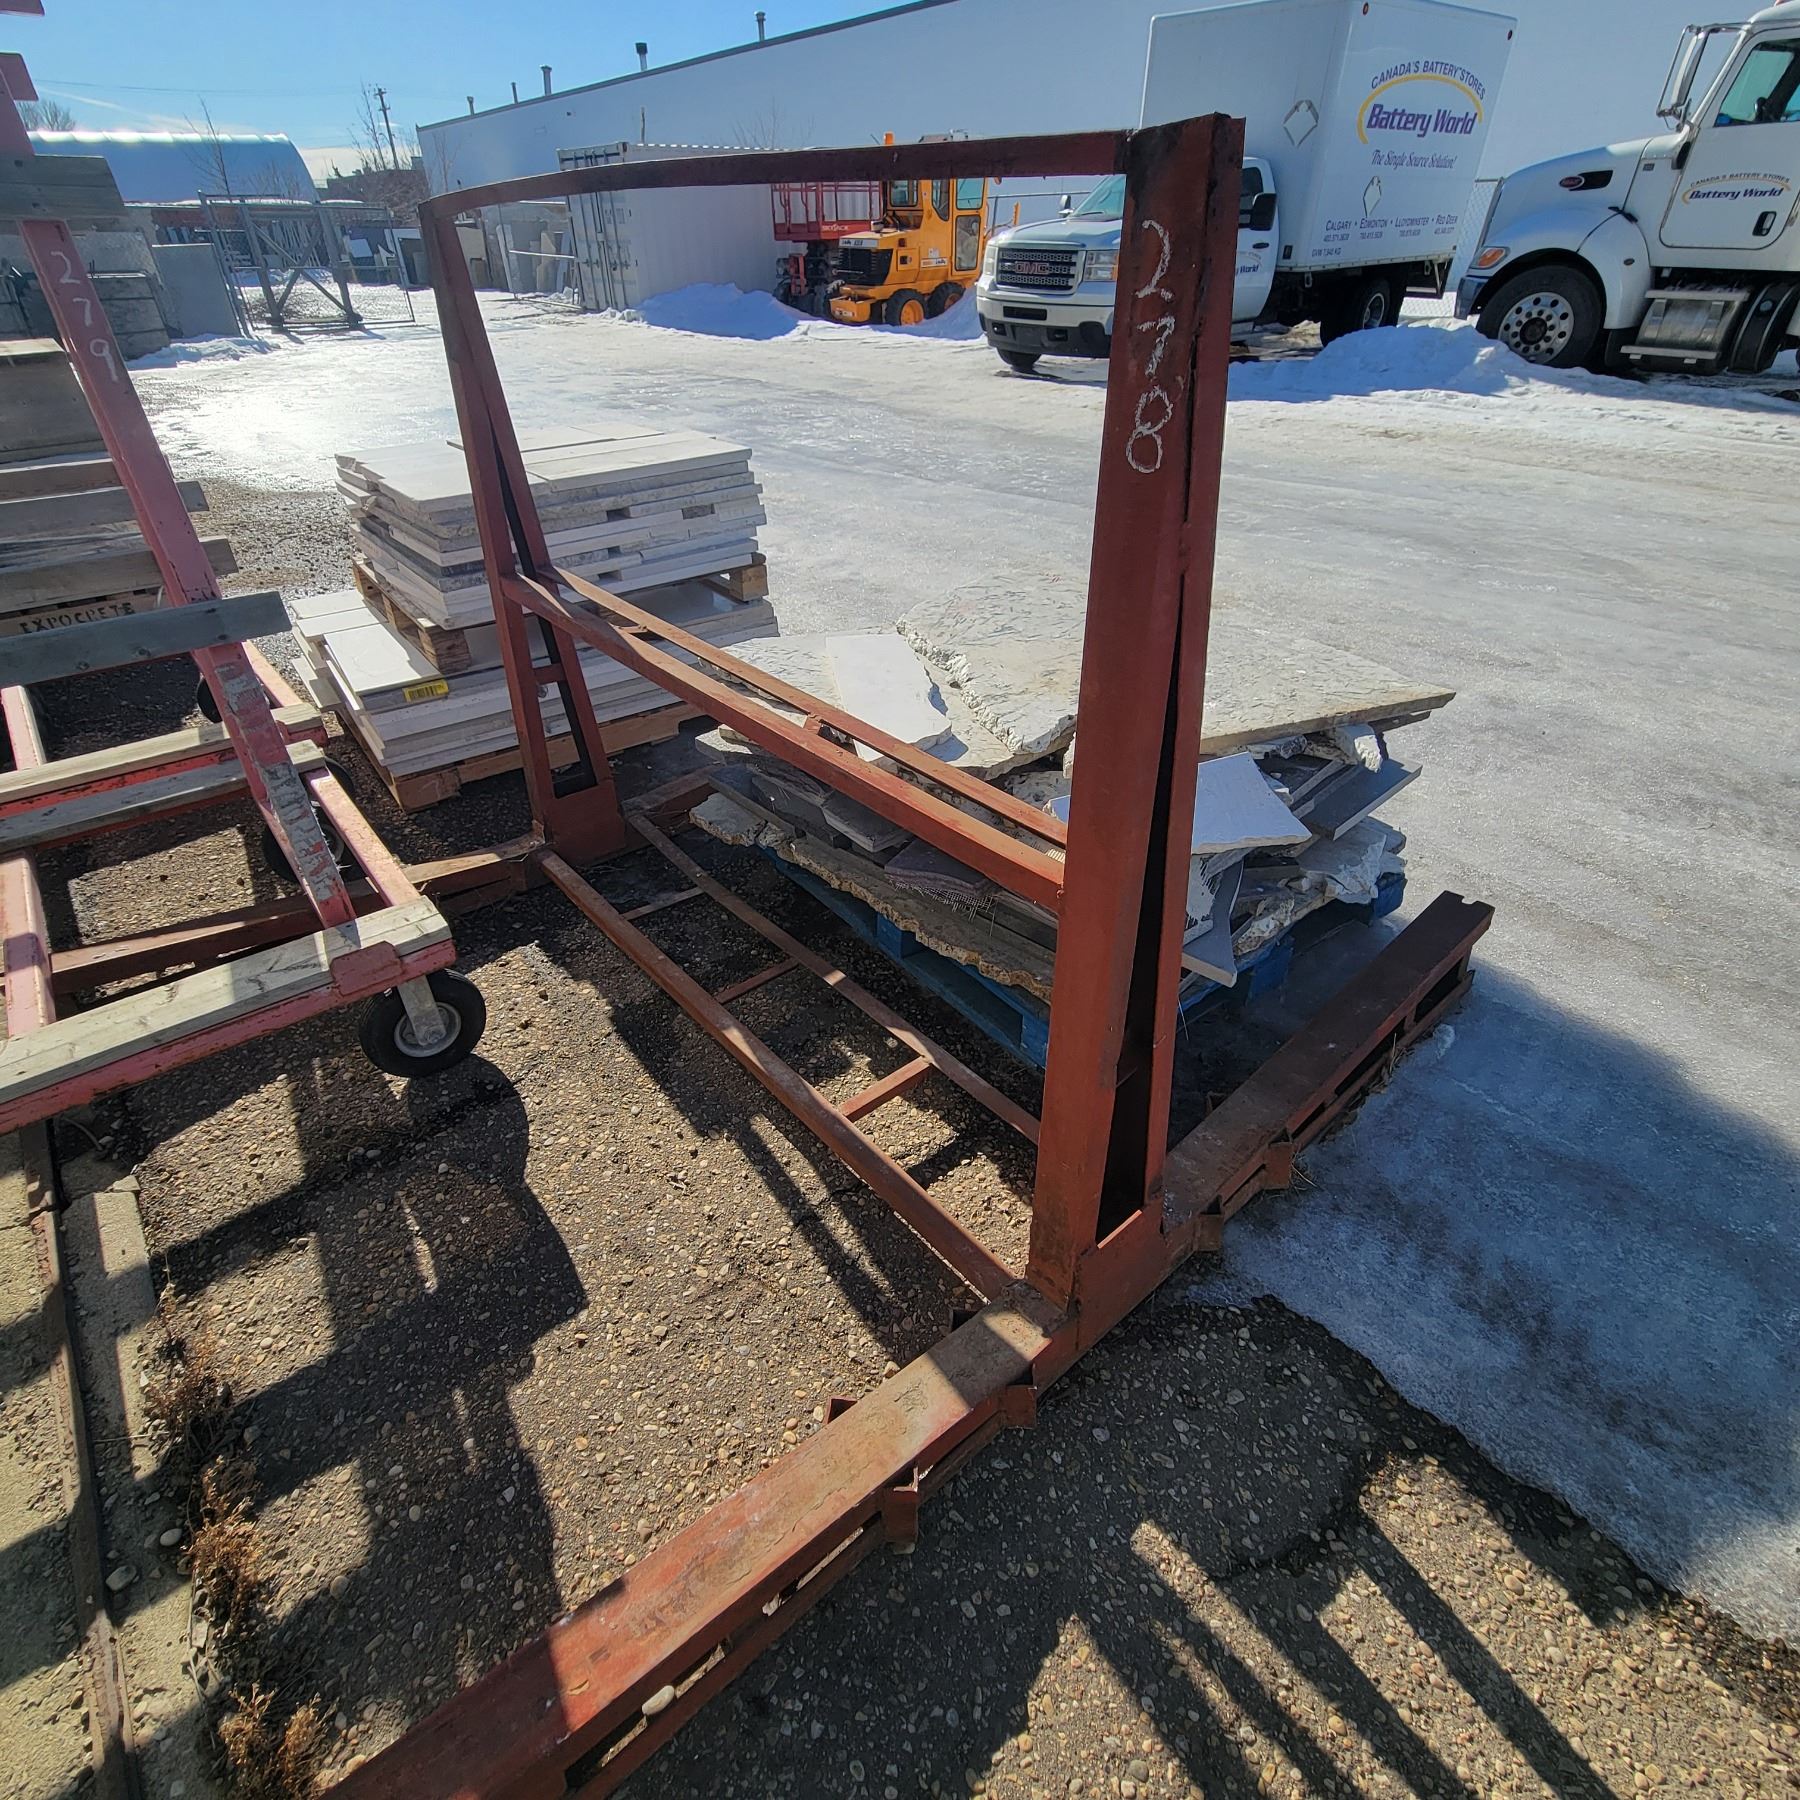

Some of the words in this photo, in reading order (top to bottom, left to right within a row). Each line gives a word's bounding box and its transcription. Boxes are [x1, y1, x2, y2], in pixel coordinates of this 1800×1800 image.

[1371, 60, 1420, 90] CANADA'S
[1422, 60, 1459, 78] BATTERY
[1459, 68, 1486, 101] STORES
[1366, 103, 1432, 138] Battery
[1433, 108, 1478, 134] World
[1371, 149, 1383, 166] The
[1405, 151, 1428, 168] Source
[1763, 172, 1790, 184] STORES
[1688, 190, 1741, 200] Battery
[1743, 187, 1784, 197] World
[1015, 261, 1049, 274] GMC
[50, 251, 120, 384] 279
[1125, 219, 1176, 474] 278
